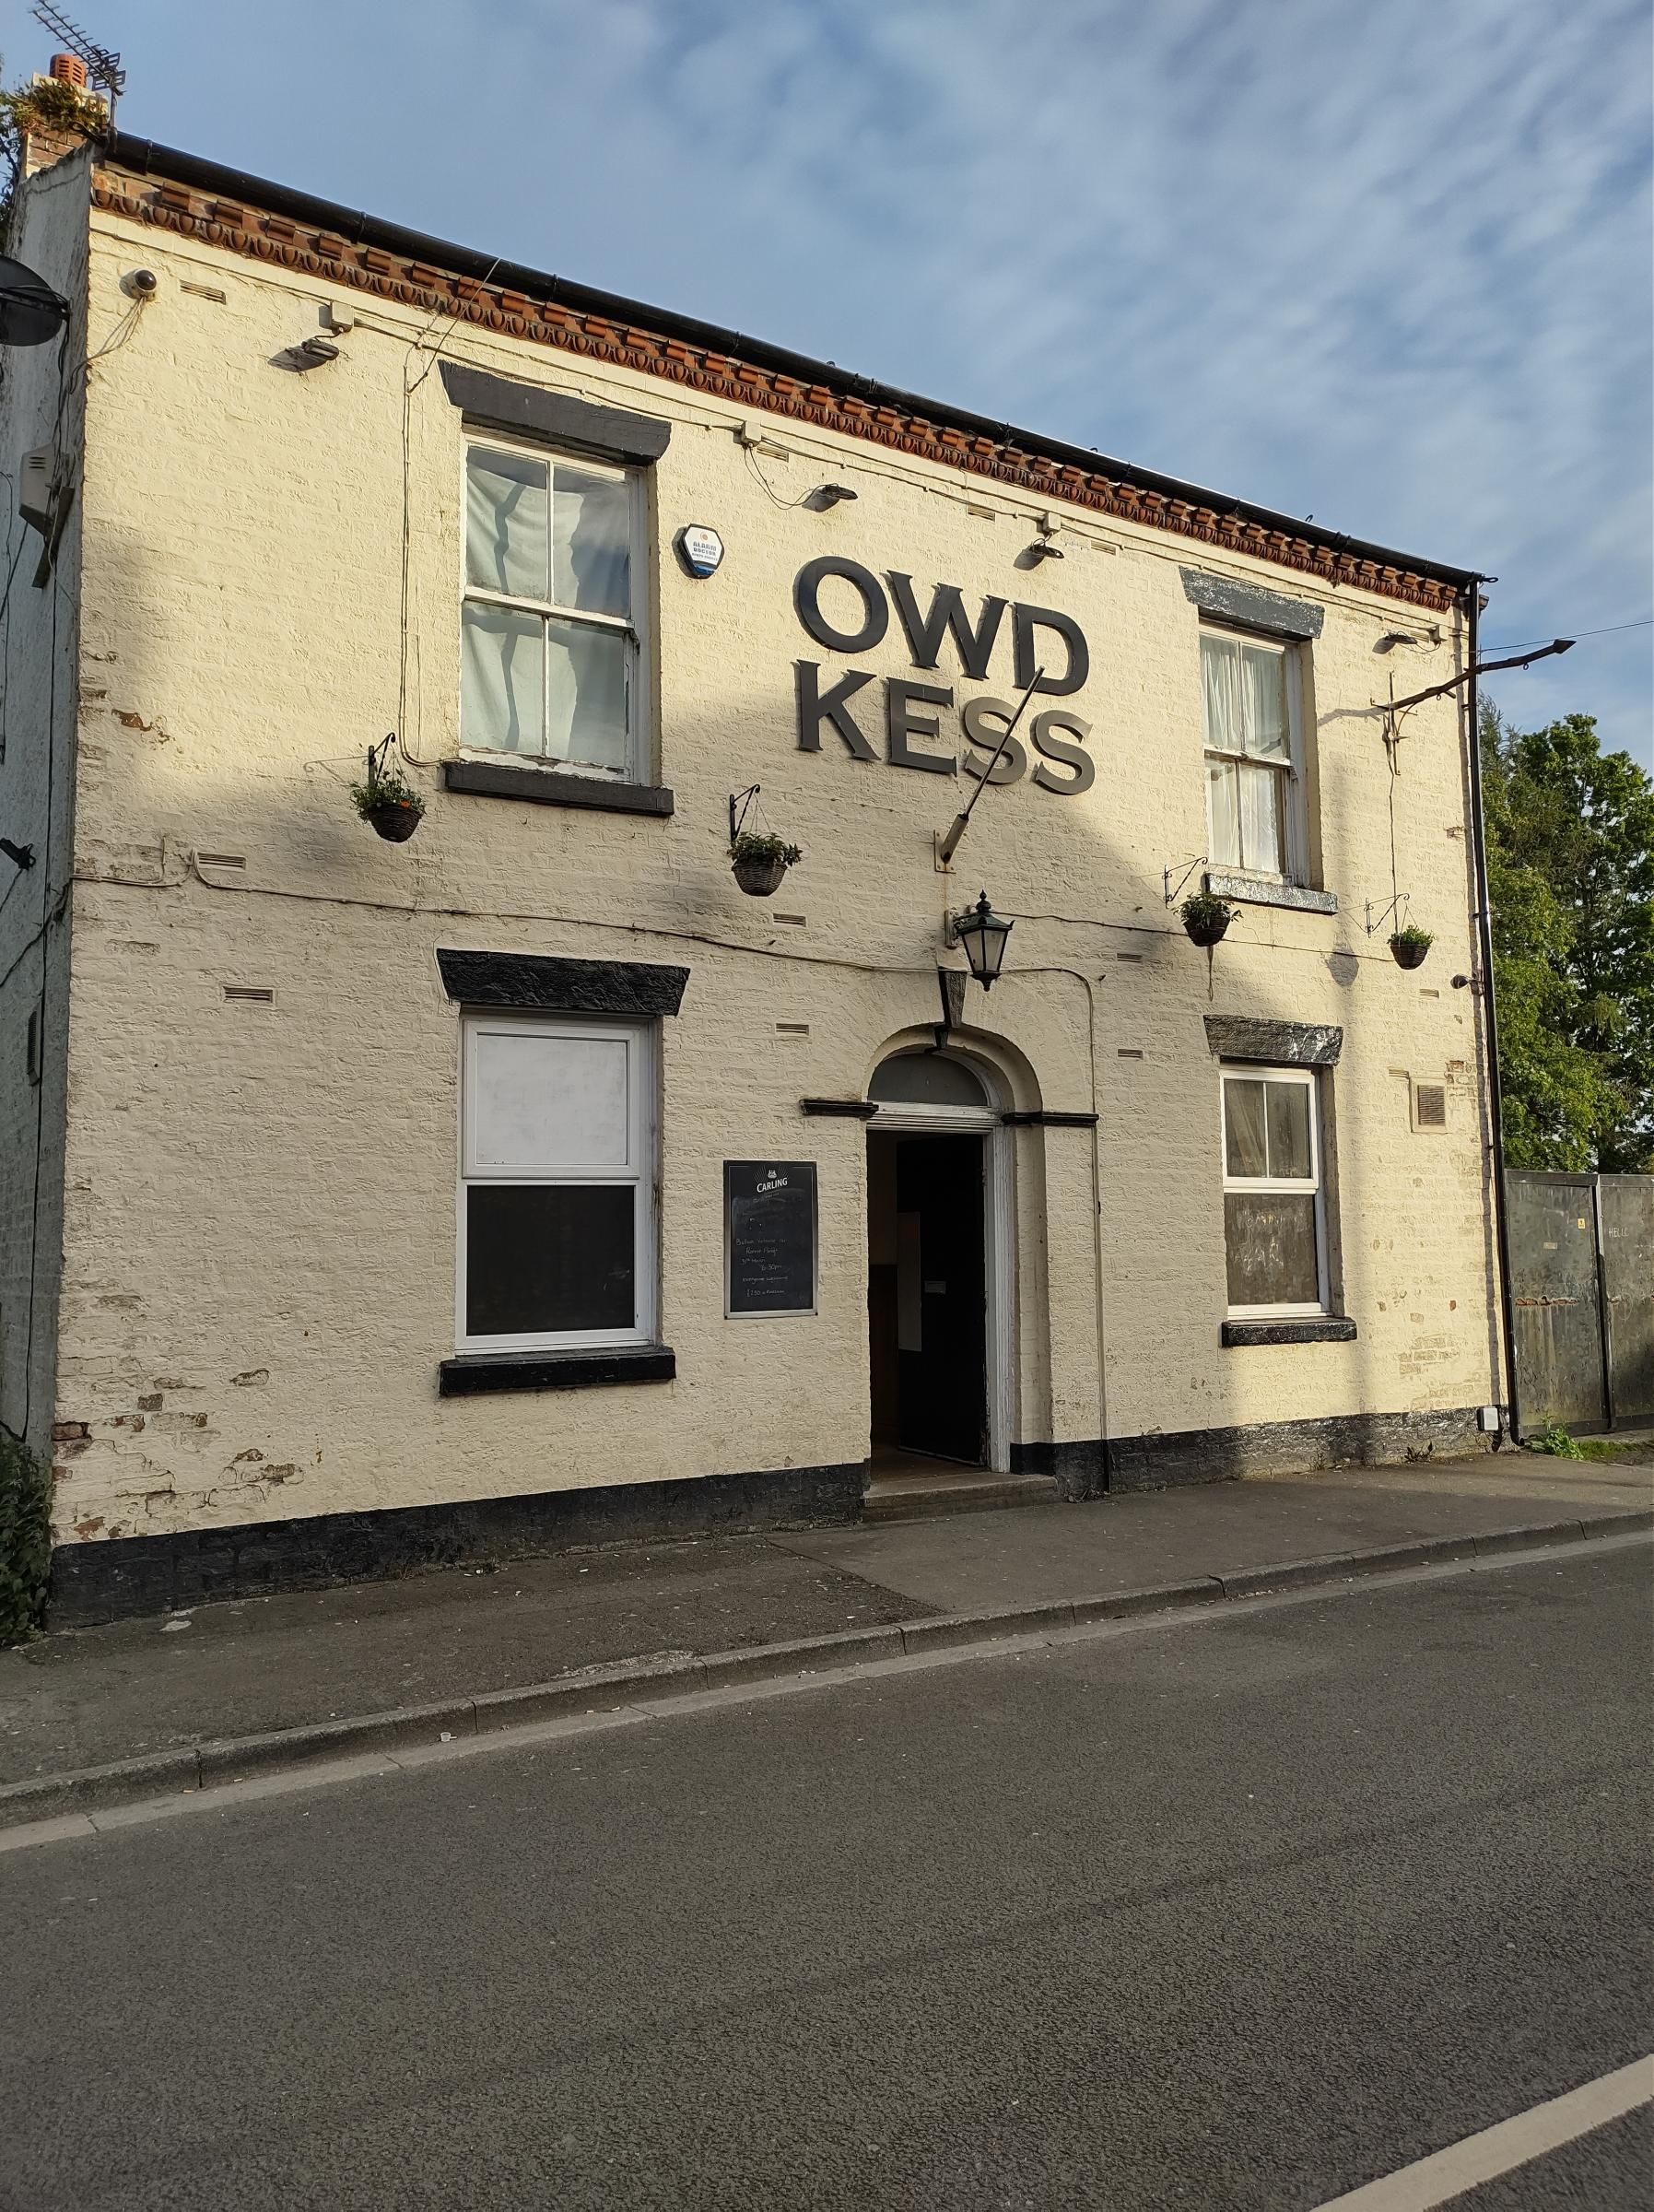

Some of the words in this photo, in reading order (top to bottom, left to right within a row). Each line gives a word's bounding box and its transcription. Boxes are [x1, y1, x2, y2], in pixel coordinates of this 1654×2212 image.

[792, 555, 1090, 696] OWD
[790, 658, 1096, 795] KESS
[757, 1177, 788, 1194] CARLING
